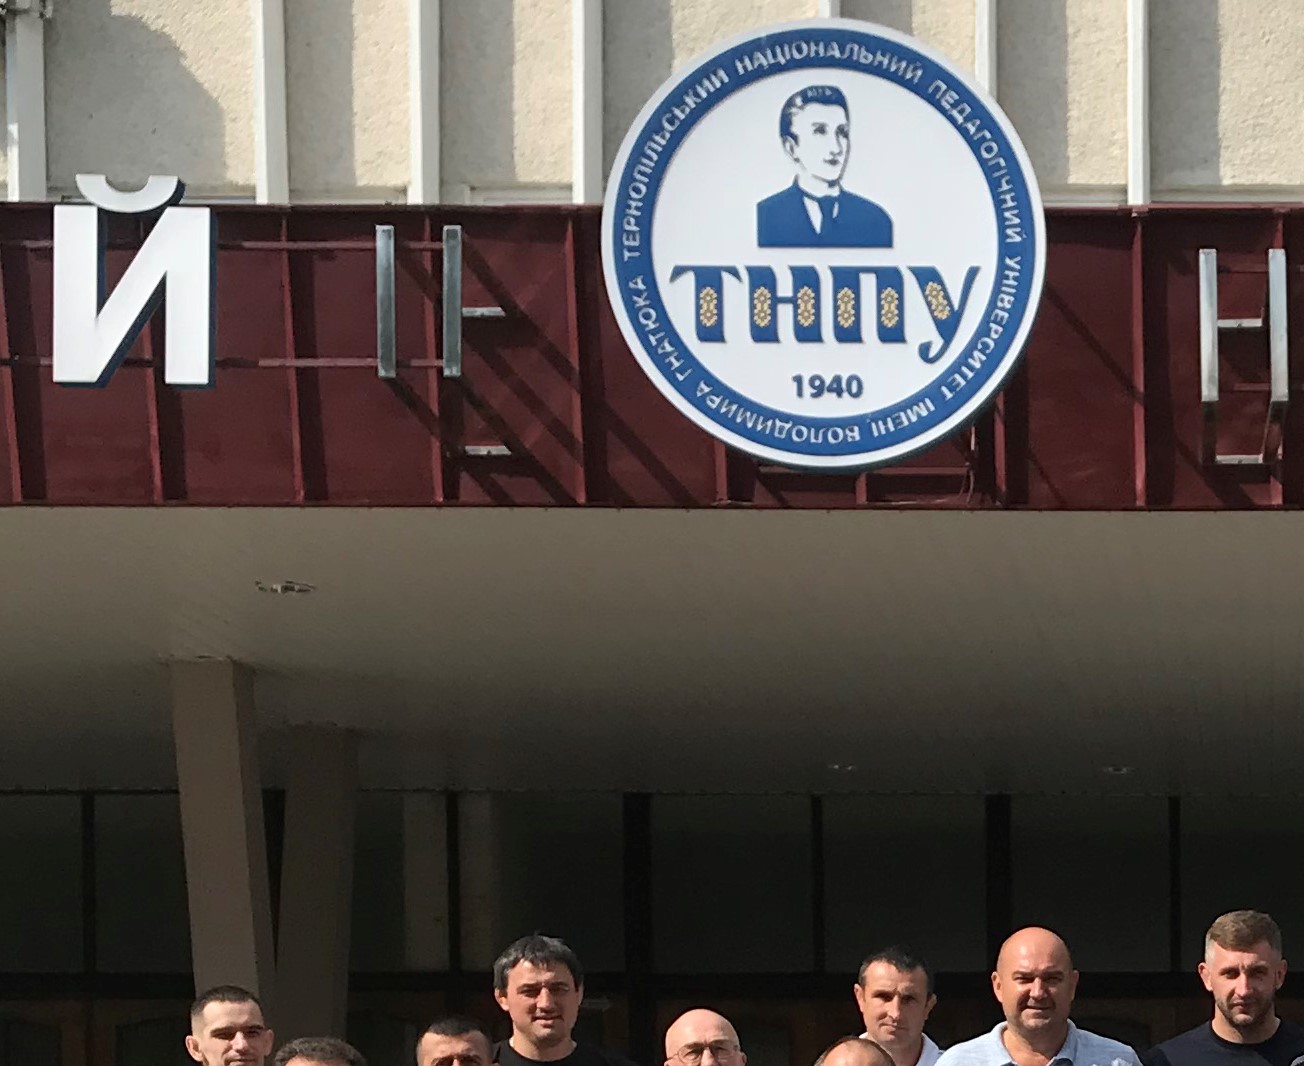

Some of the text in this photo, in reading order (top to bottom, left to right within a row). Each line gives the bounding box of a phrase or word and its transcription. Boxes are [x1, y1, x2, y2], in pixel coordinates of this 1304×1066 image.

[735, 40, 924, 84] НАЦІОНАЛЬНИЙ
[928, 79, 1028, 244] ПЕДАГОГІЧНИЙ
[628, 274, 693, 382] ГНАТЮКА
[669, 265, 982, 364] ТНПУ
[940, 256, 1022, 401] УНІВЕРСИТЕТ
[696, 380, 860, 444] ВОЛОДИМИРА
[791, 374, 864, 400] 1940
[870, 397, 936, 438] ІМЕНІ
